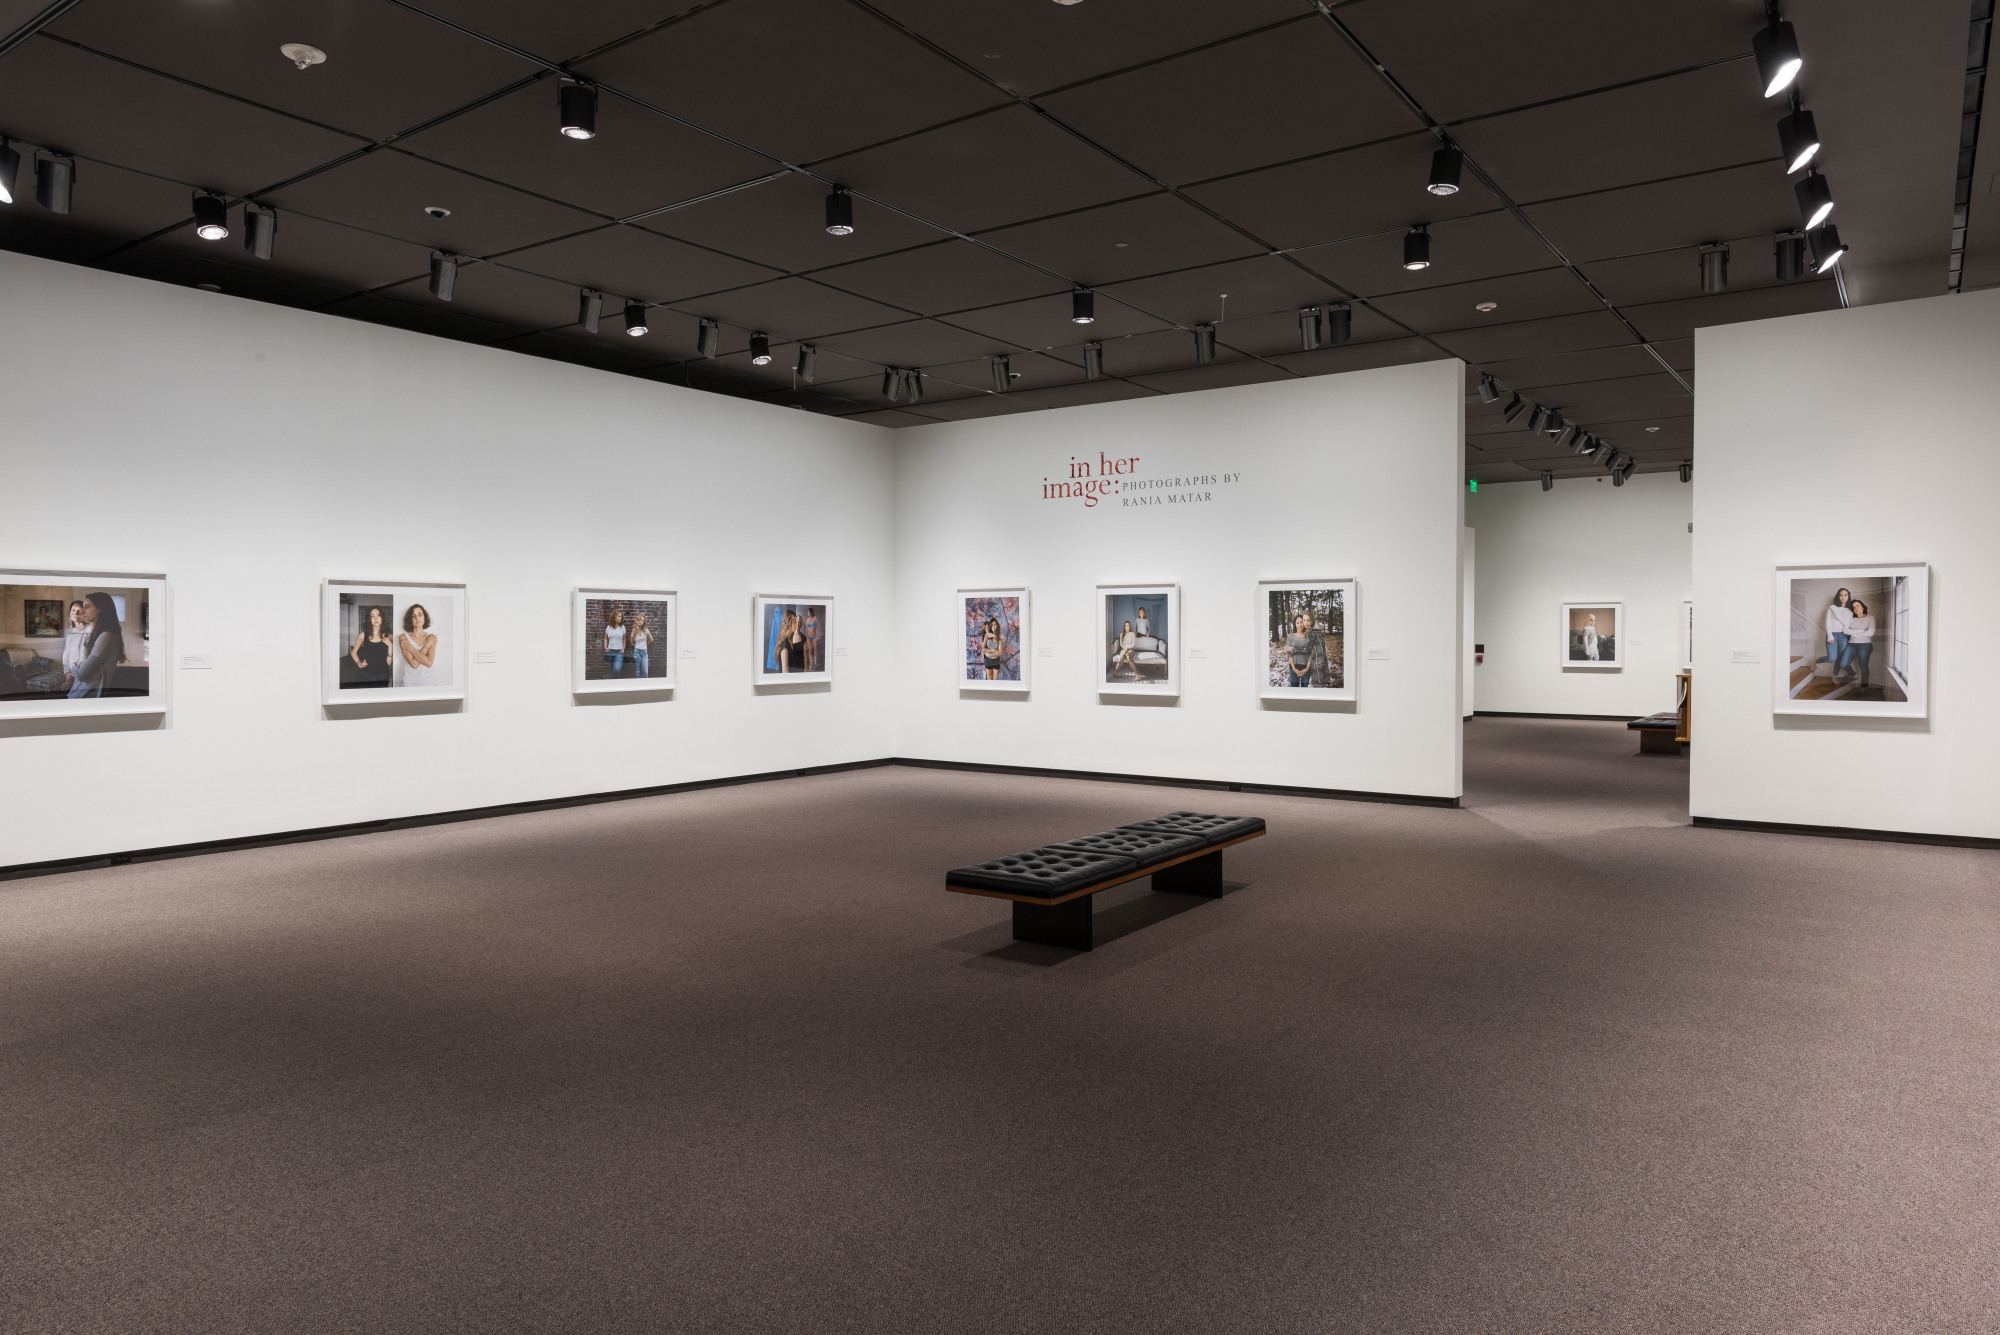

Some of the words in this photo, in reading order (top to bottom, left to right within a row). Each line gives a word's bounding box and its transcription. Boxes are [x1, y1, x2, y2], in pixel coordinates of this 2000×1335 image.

[1069, 456, 1091, 479] in
[1098, 451, 1140, 476] her
[1041, 477, 1120, 507] image:
[1122, 475, 1217, 491] PHOTOGRAPHS
[1224, 472, 1242, 483] BY
[1122, 496, 1162, 507] RANIA
[1167, 492, 1212, 504] MATAR
